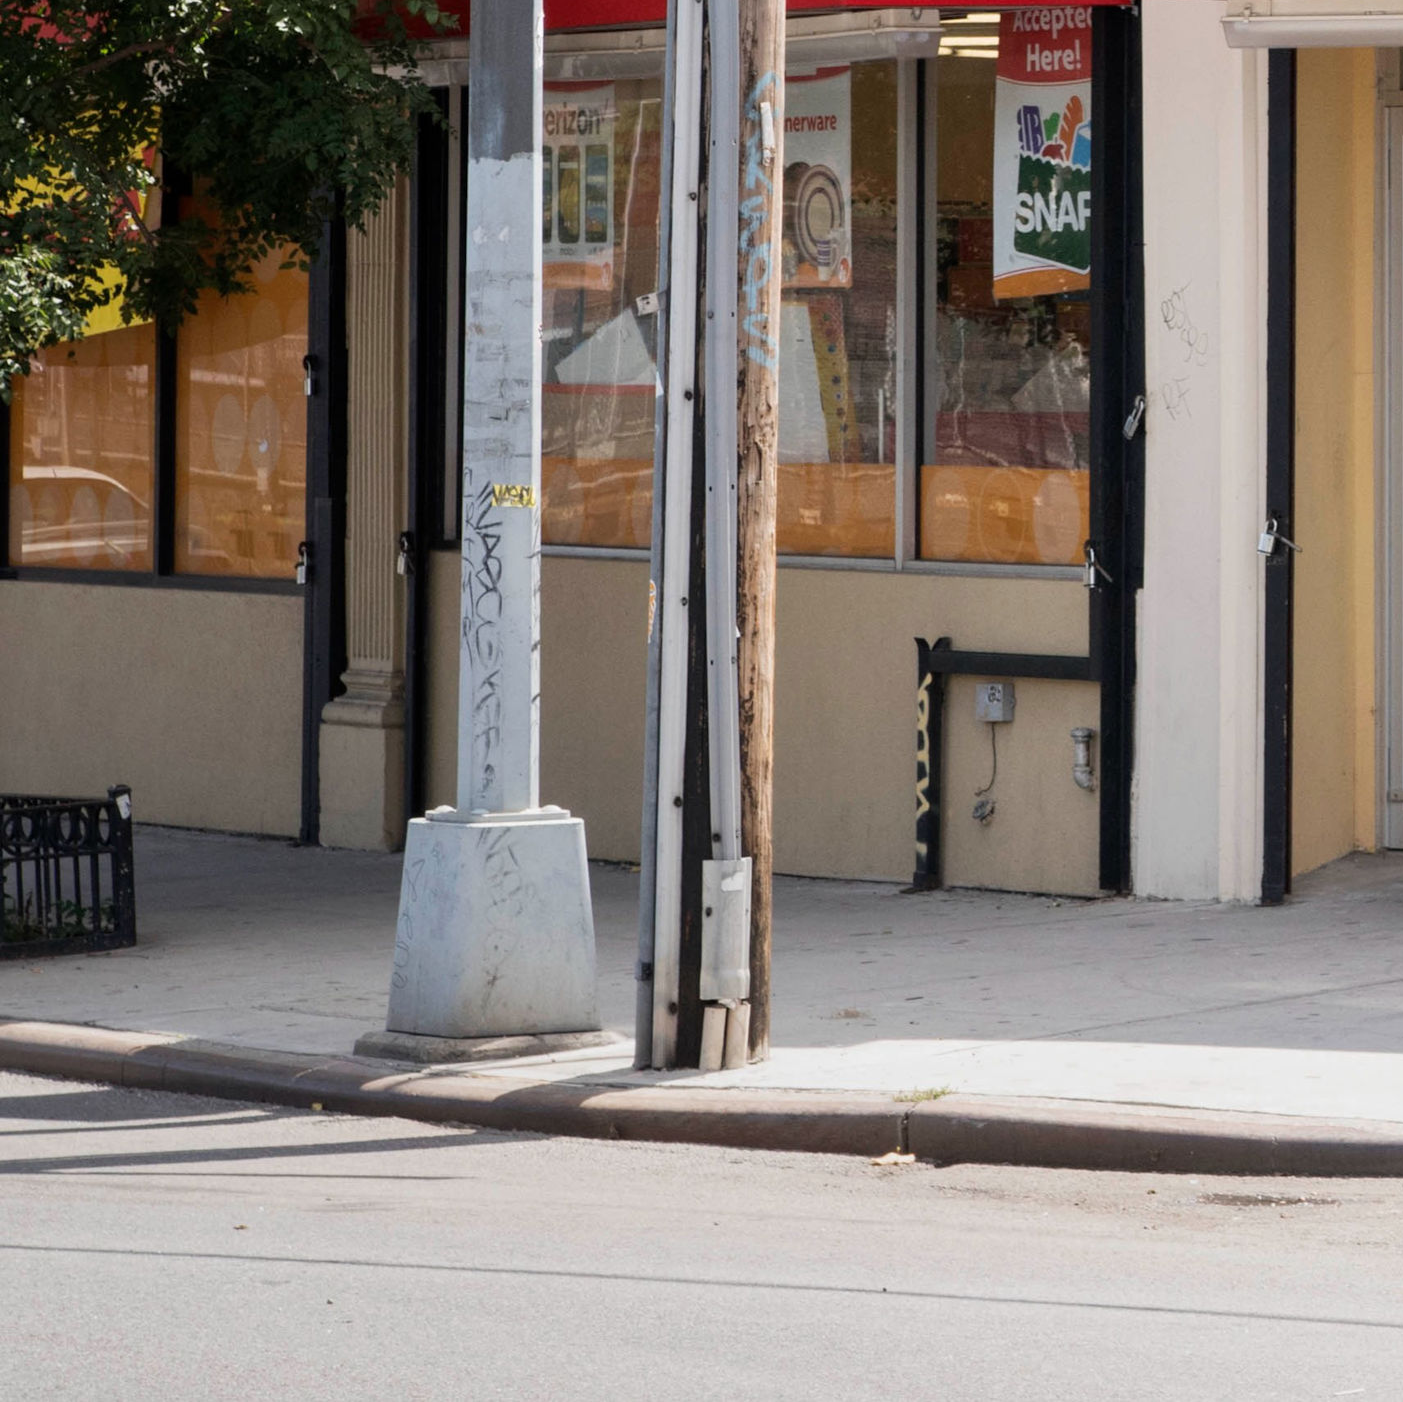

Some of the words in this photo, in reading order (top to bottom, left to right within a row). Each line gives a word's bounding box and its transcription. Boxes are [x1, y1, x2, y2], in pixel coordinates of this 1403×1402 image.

[1012, 6, 1092, 39] Accepte
[1026, 39, 1082, 73] Here!
[543, 102, 602, 136] erizon
